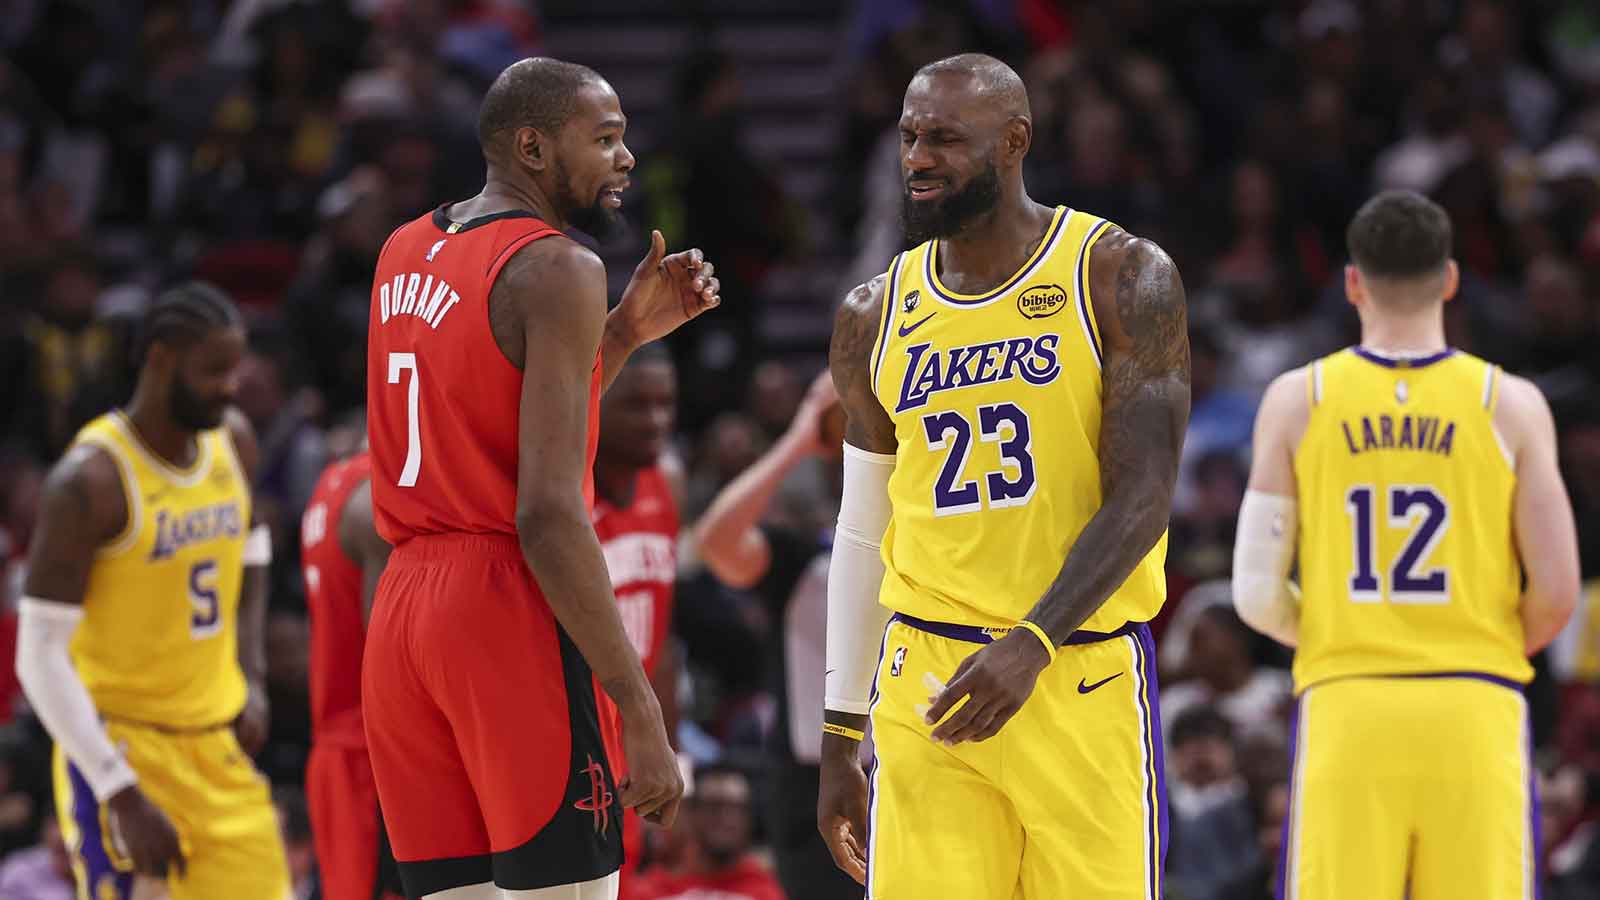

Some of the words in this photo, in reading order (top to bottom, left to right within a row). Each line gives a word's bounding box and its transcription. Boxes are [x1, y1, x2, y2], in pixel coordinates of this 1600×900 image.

[380, 272, 460, 329] DURANT
[1022, 293, 1063, 307] bibigo
[895, 334, 1062, 414] LAKERS
[387, 352, 422, 487] 7
[922, 402, 1038, 517] 23
[1341, 414, 1456, 457] LARAVIA
[1345, 485, 1451, 604] 12
[188, 557, 223, 638] 5
